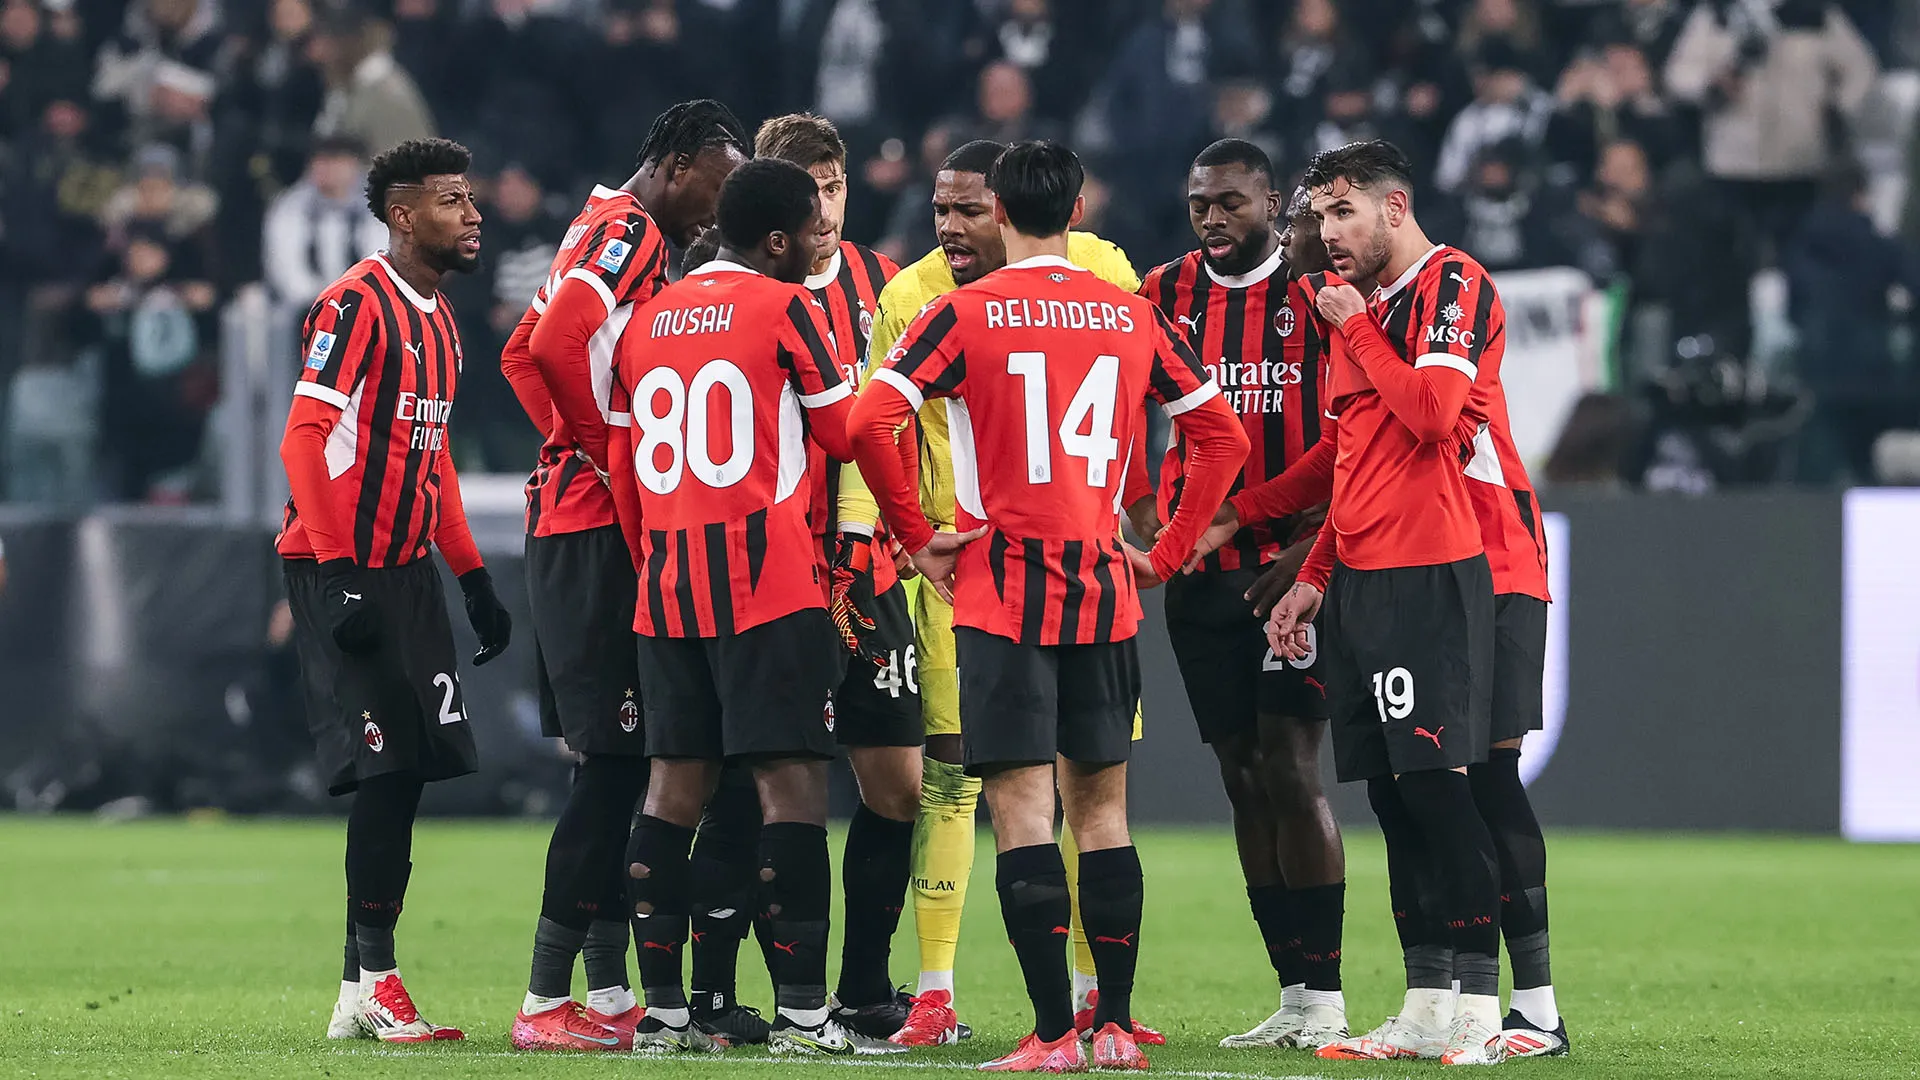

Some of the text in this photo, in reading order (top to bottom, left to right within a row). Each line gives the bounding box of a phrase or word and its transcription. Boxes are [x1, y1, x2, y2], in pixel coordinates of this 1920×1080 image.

[651, 303, 734, 339] MUSAH
[985, 298, 1134, 333] REIJNDERS
[1423, 325, 1476, 348] MSC
[396, 391, 453, 424] Emira
[1007, 351, 1120, 488] 14
[410, 426, 432, 450] FLY
[632, 358, 755, 495] 80
[433, 671, 467, 725] 2
[1373, 666, 1415, 723] 19
[912, 876, 956, 891] MILAN
[1447, 915, 1492, 929] MILAN
